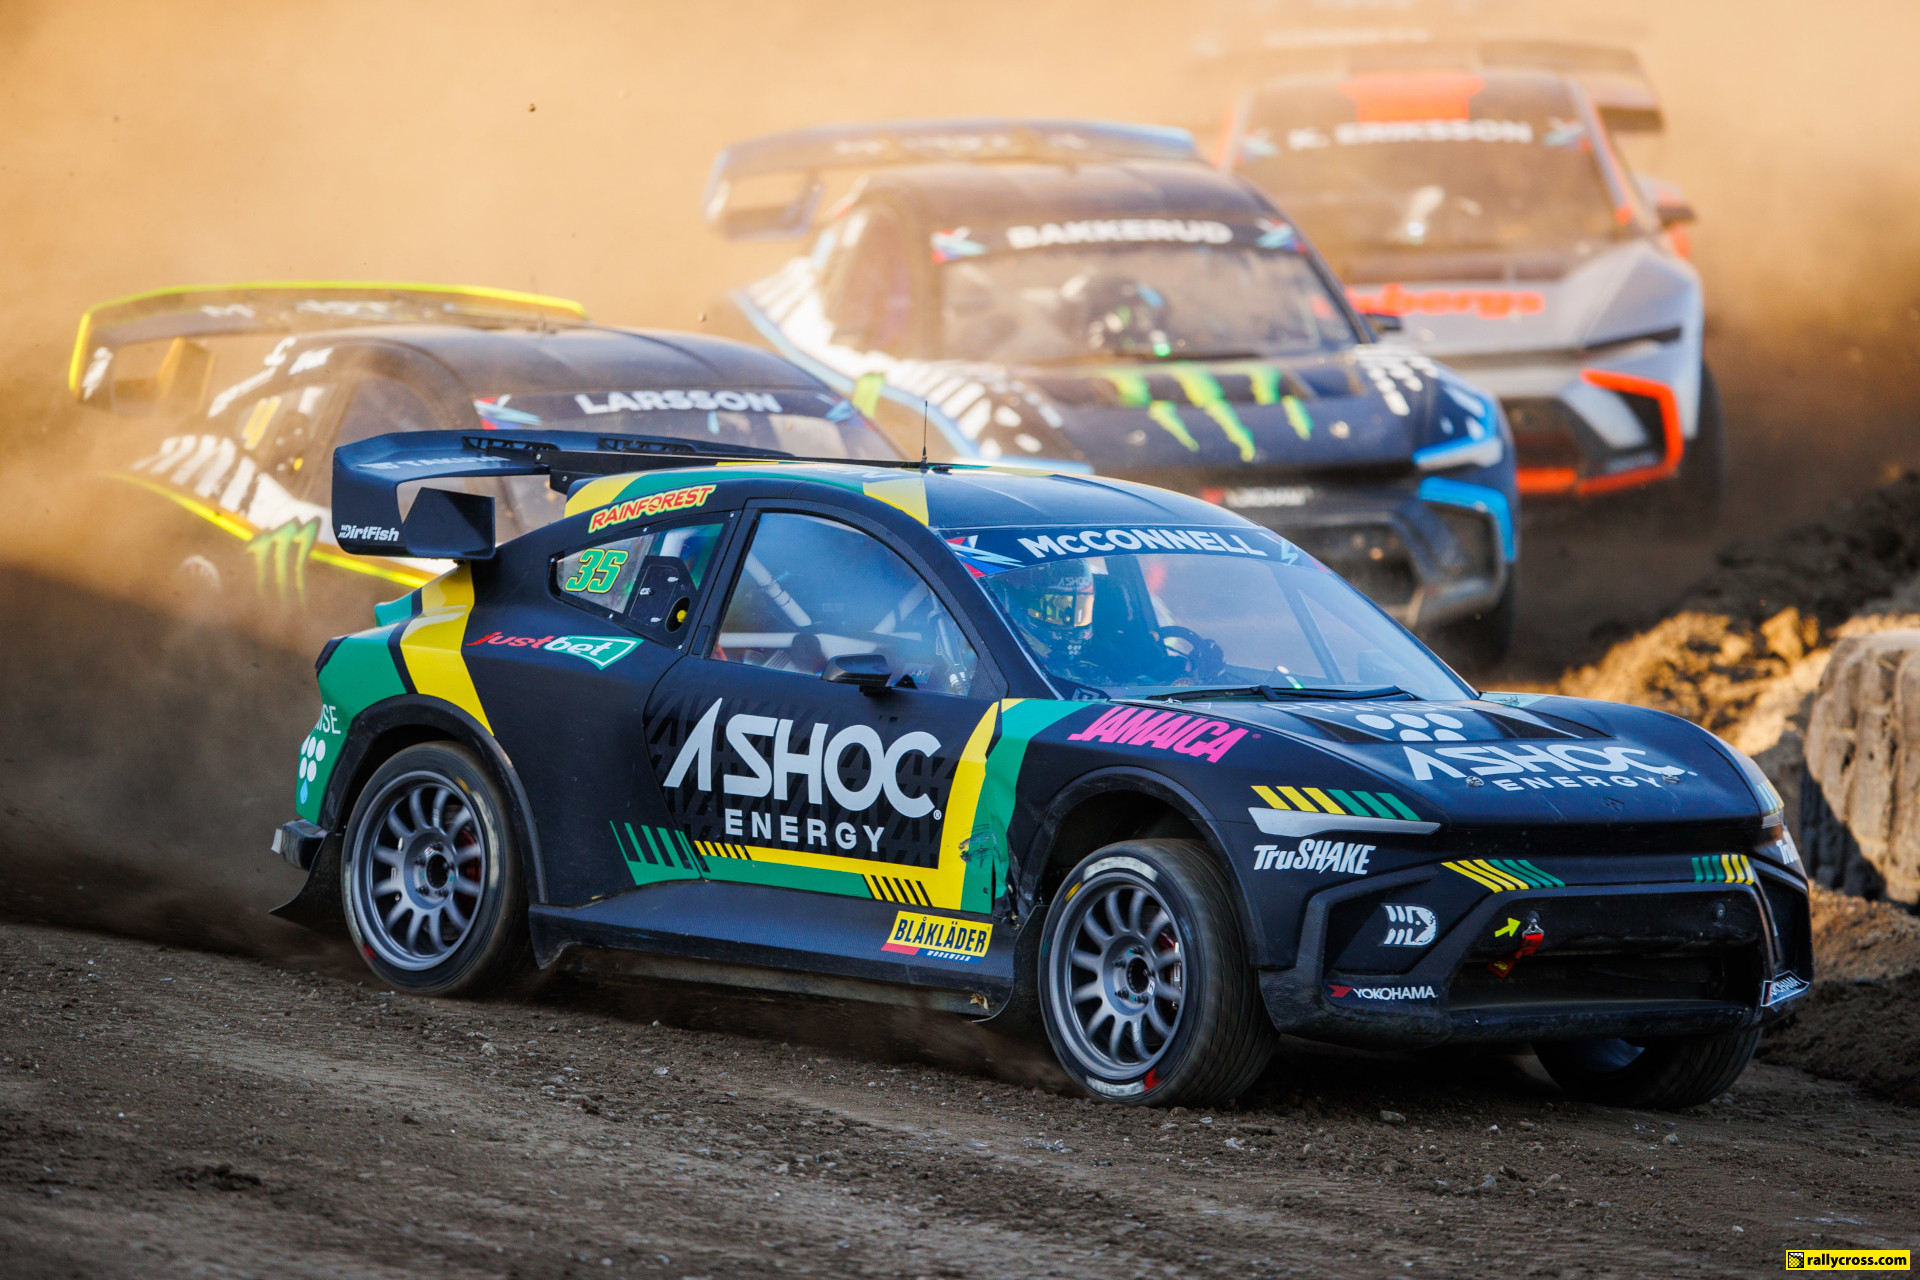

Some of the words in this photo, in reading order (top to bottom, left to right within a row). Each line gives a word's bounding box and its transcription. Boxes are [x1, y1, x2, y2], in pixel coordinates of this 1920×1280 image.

[1007, 219, 1234, 249] BAKKERUD
[575, 390, 783, 414] LARSSON
[589, 485, 716, 532] RAINFOREST
[338, 524, 400, 541] DirtFish
[565, 548, 629, 594] 35
[1067, 705, 1249, 763] JAMAICA
[663, 697, 942, 818] ASHOC
[1402, 744, 1687, 781] ASHOC
[1491, 775, 1664, 792] ENERGY
[725, 808, 885, 852] ENERGY
[1253, 838, 1376, 875] TruSHAKE
[893, 916, 987, 953] BLÅKLÄDER
[1353, 985, 1436, 1001] YOKOHAMA
